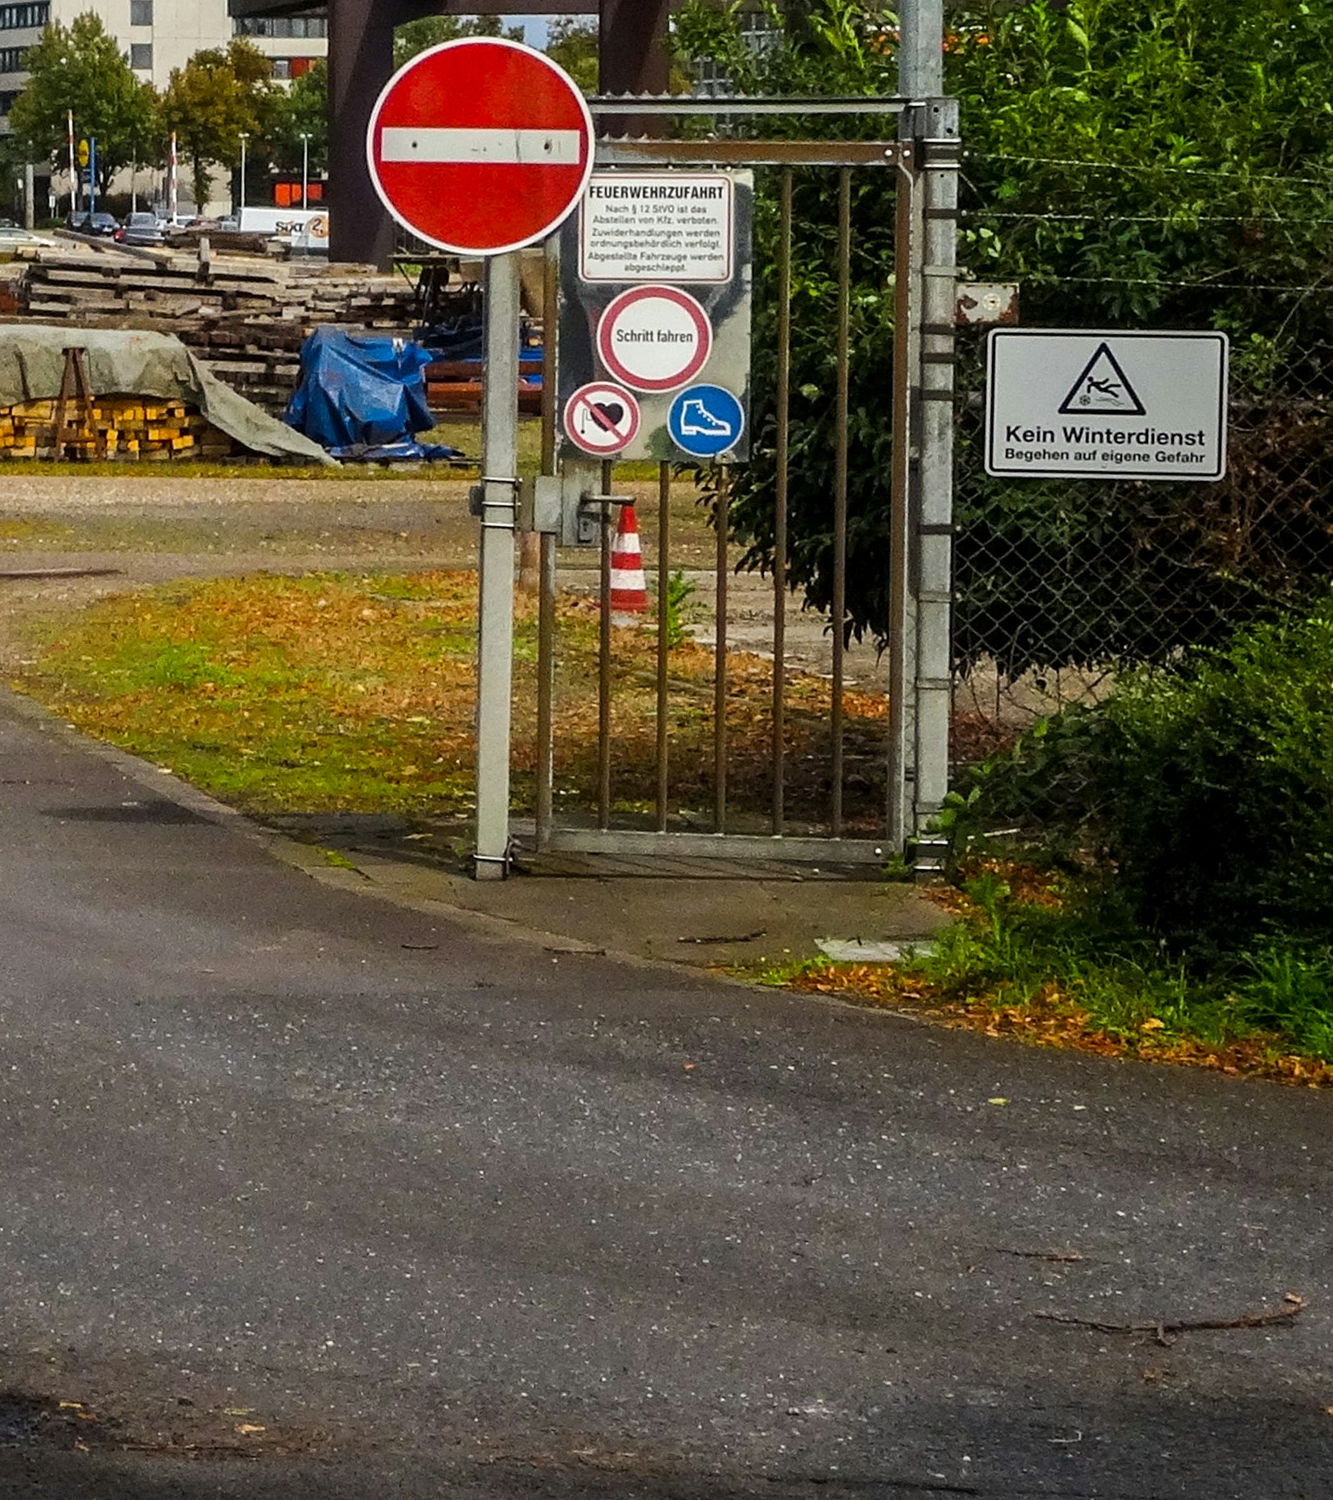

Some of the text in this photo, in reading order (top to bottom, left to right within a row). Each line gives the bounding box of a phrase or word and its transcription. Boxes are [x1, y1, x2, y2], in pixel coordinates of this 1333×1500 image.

[589, 185, 724, 199] FEUERWEHRZUFAHRT
[605, 204, 629, 213] Nach
[640, 204, 650, 213] 12
[677, 204, 688, 213] ist
[690, 204, 707, 214] das
[593, 215, 636, 225] Abstellen
[592, 227, 721, 239] Zuwiderhandlungen werden
[588, 251, 724, 263] Abgestellte Fahrzeuge werden
[616, 329, 693, 342] Schritt fahren
[1006, 425, 1206, 446] Kein Winterdienst
[1005, 448, 1206, 464] Begehen auf eigene Gefahr
